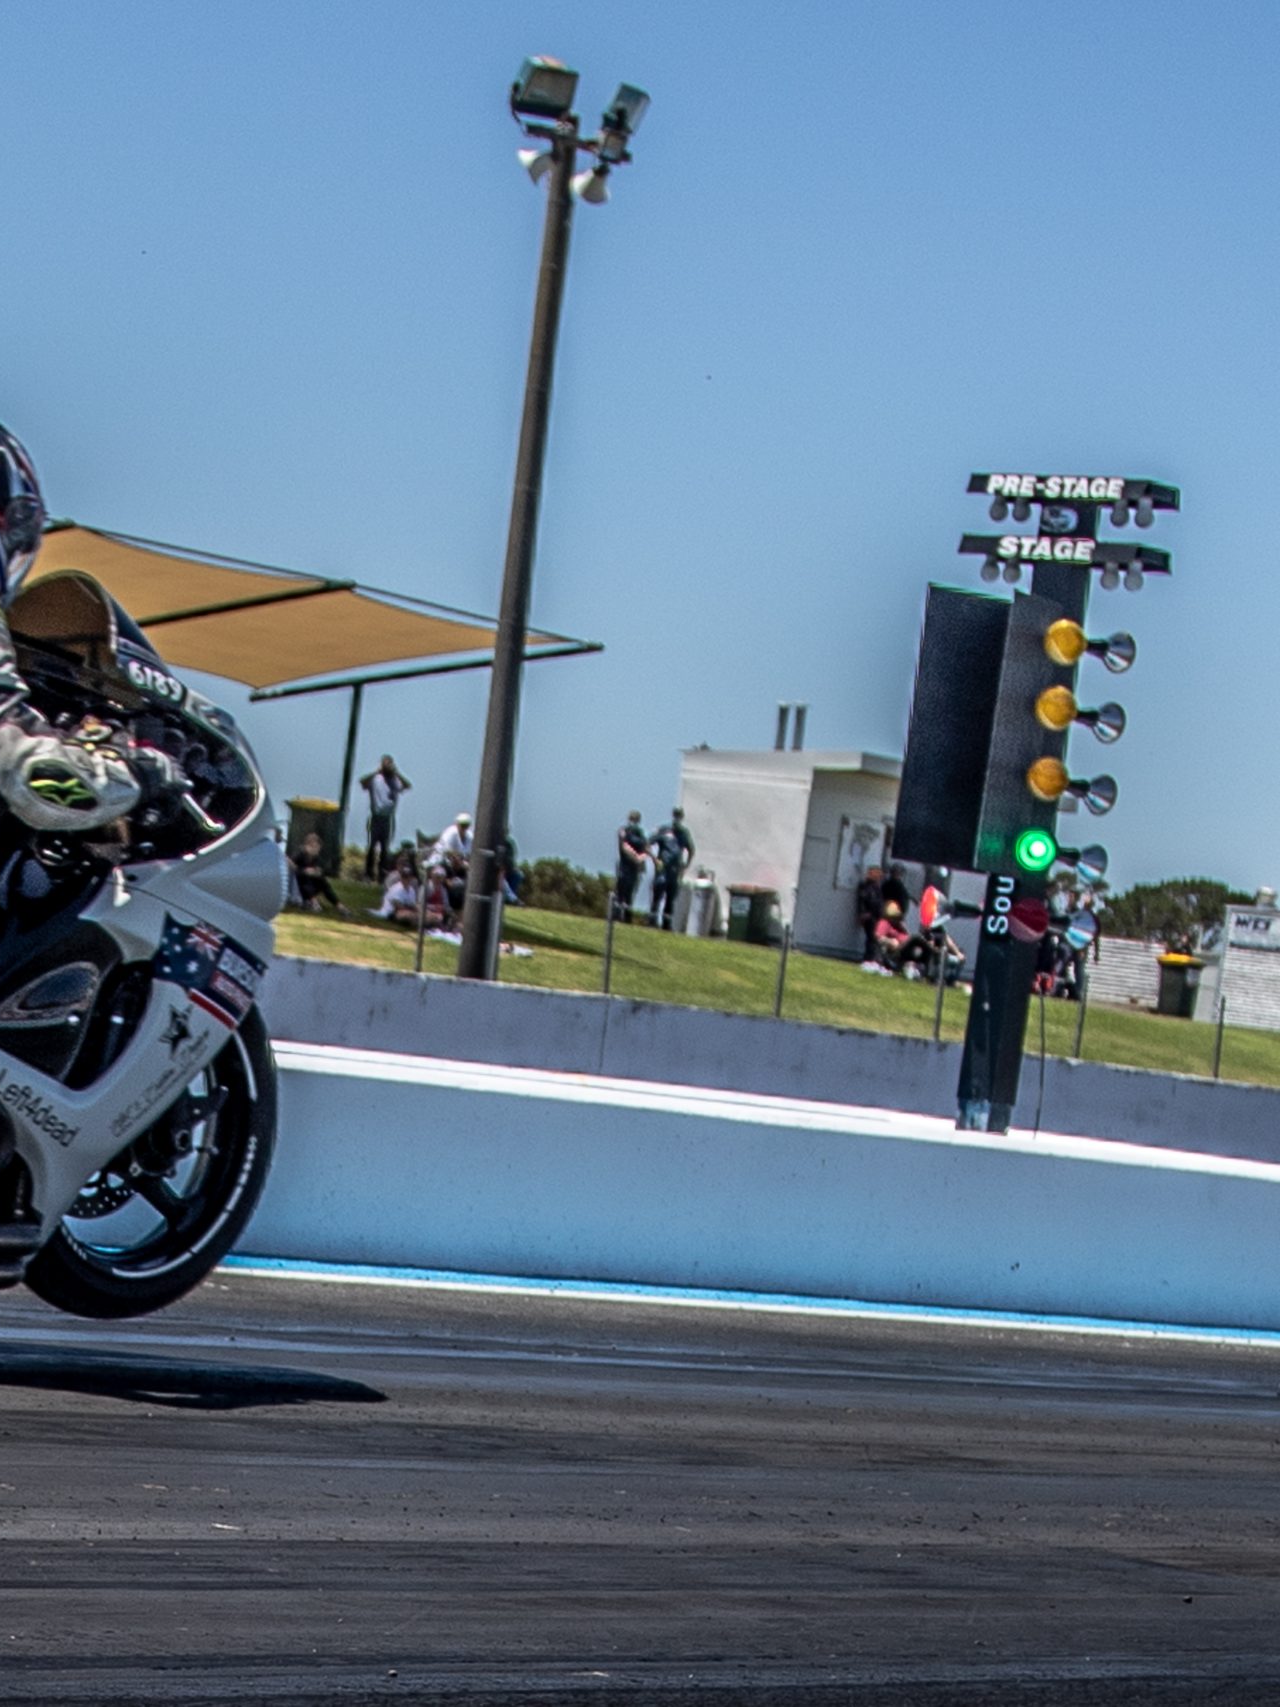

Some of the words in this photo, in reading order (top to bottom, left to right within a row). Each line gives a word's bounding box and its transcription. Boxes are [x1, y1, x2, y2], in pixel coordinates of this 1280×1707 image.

[986, 474, 1124, 499] PRE-STAGE
[998, 536, 1096, 562] STAGE
[128, 660, 183, 702] 6189
[986, 875, 1015, 934] Sou
